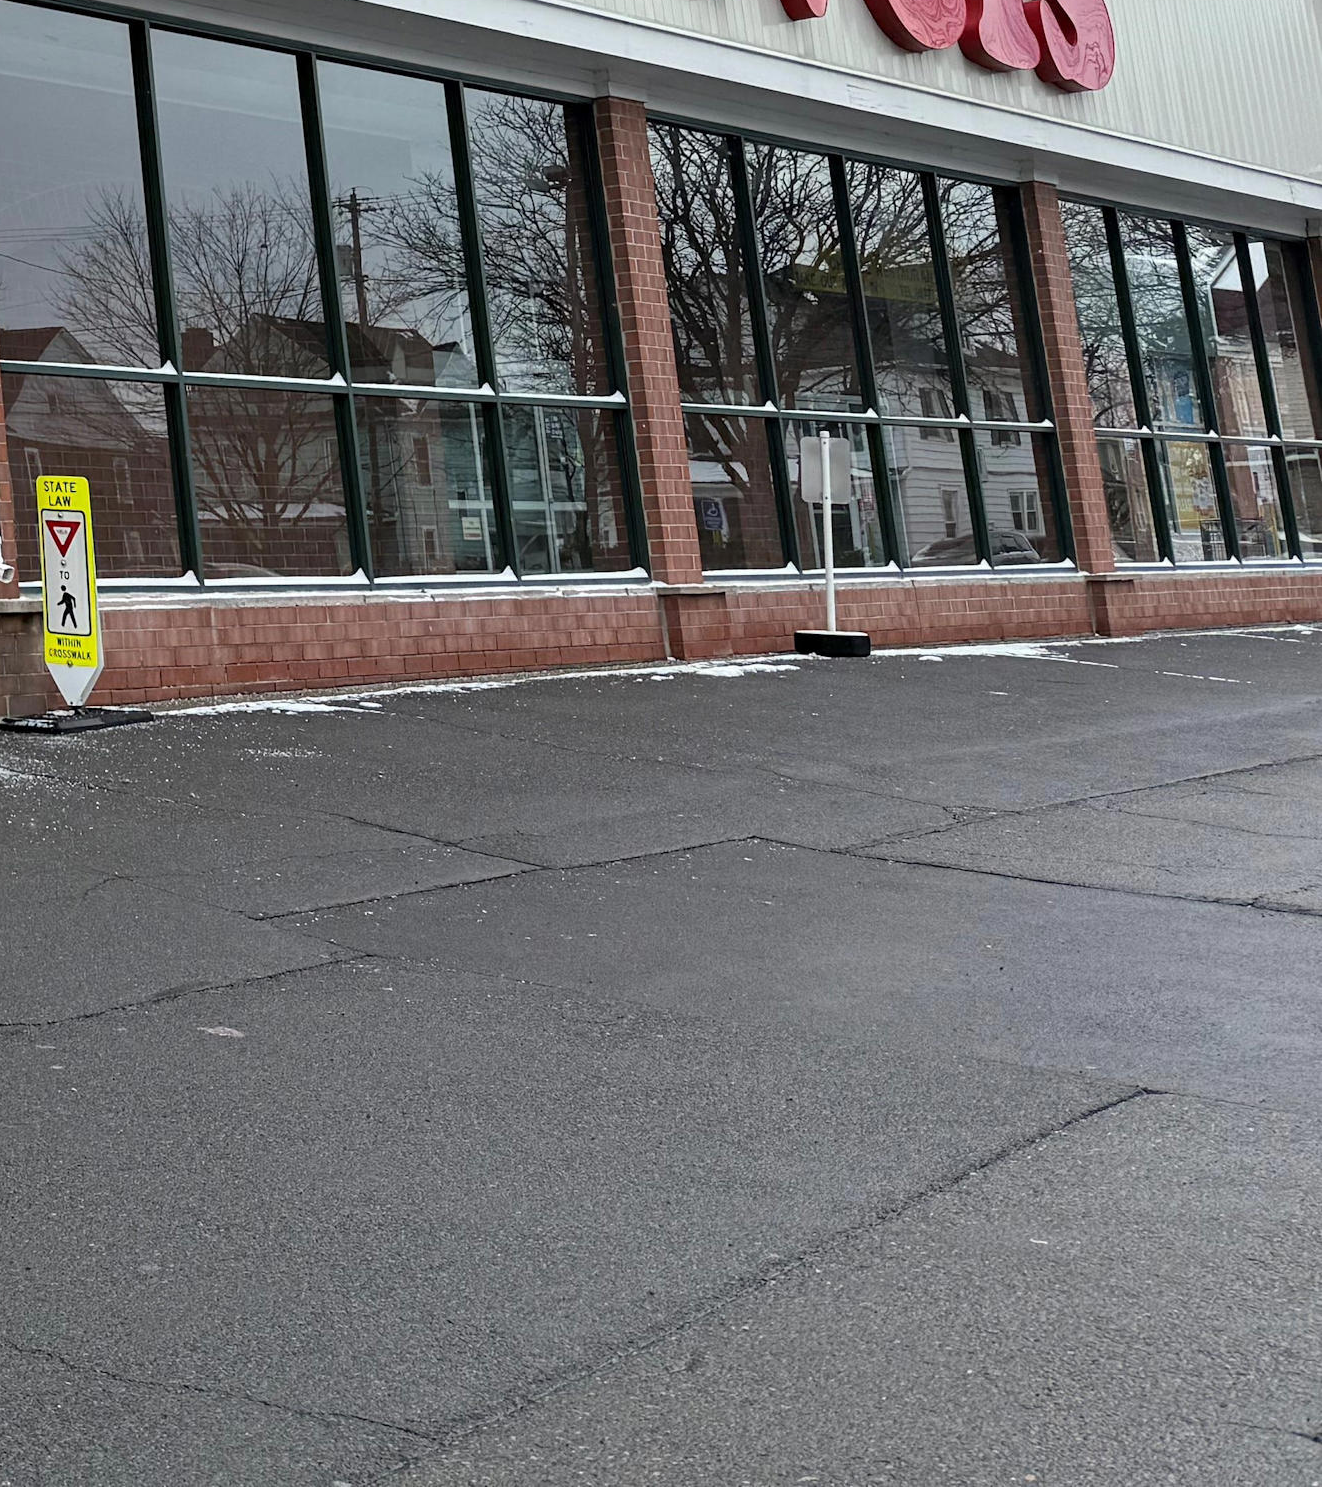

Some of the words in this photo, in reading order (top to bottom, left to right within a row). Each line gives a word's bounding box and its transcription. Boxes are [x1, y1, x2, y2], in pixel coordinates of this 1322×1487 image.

[44, 481, 77, 493] STATE
[49, 495, 71, 507] LAW
[59, 570, 70, 580] TO
[57, 638, 82, 648] WITHIN
[49, 648, 92, 660] CROSSWALK
